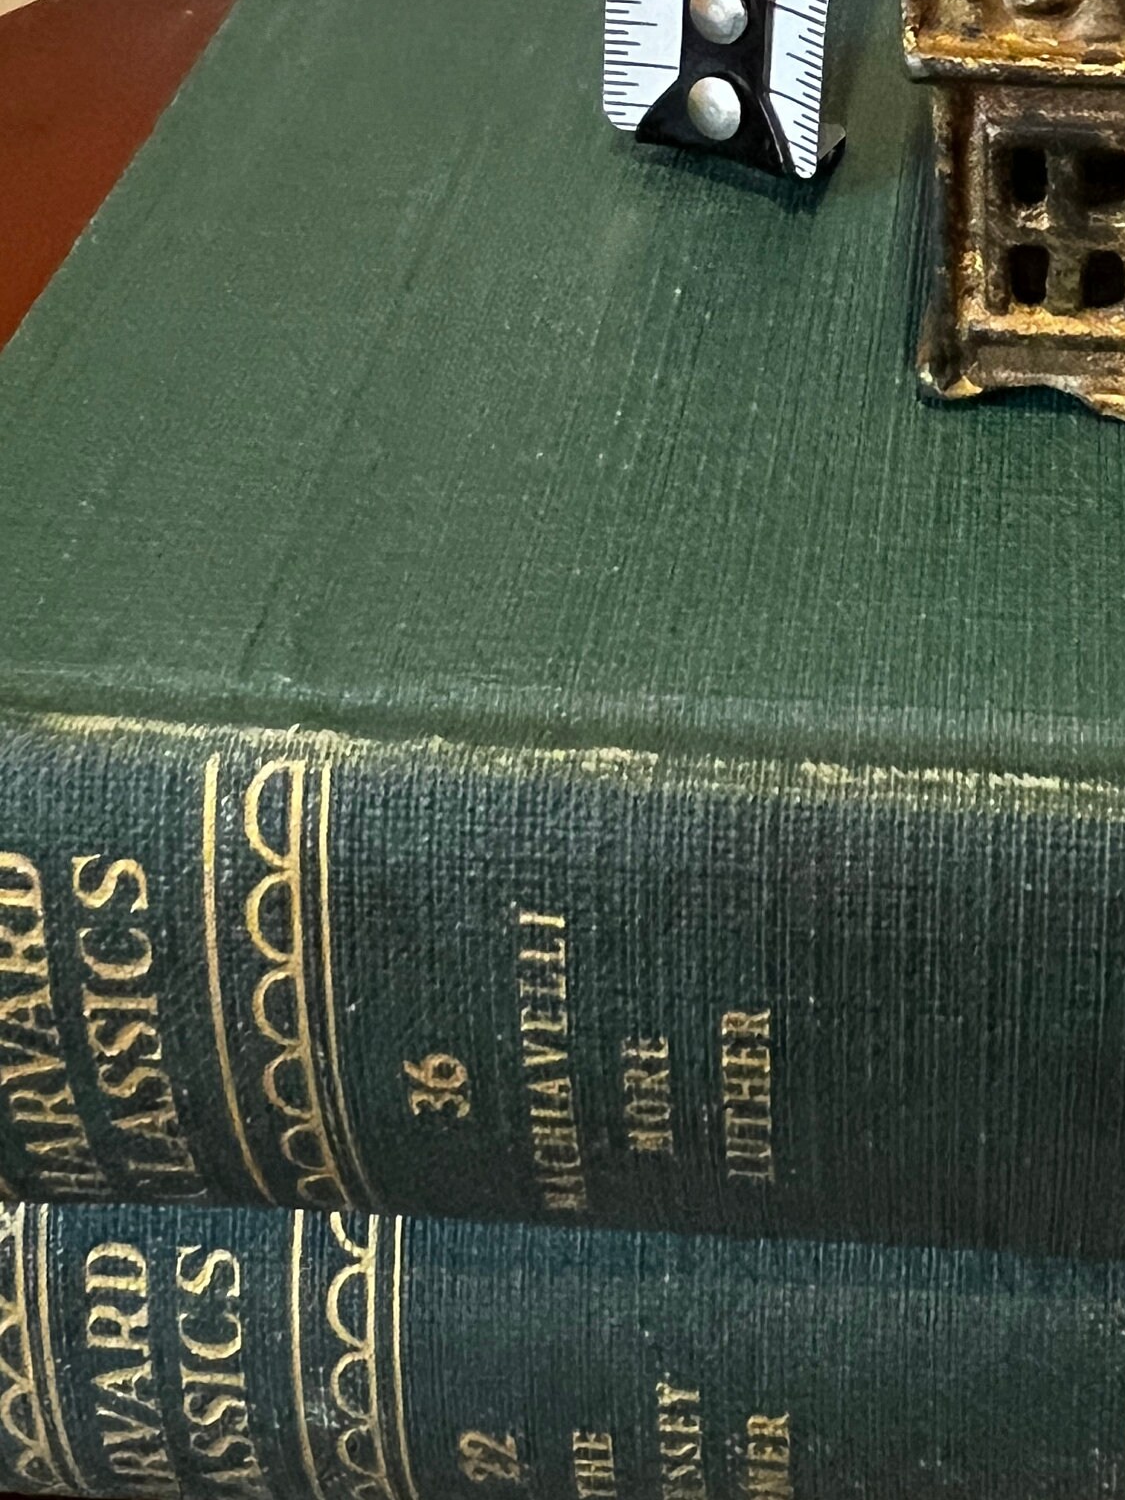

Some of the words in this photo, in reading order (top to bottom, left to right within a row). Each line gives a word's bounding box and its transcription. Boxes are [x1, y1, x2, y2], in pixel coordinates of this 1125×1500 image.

[402, 1052, 471, 1119] 36
[518, 908, 587, 1212] MACHIAVELLI
[620, 1034, 675, 1154] MORE
